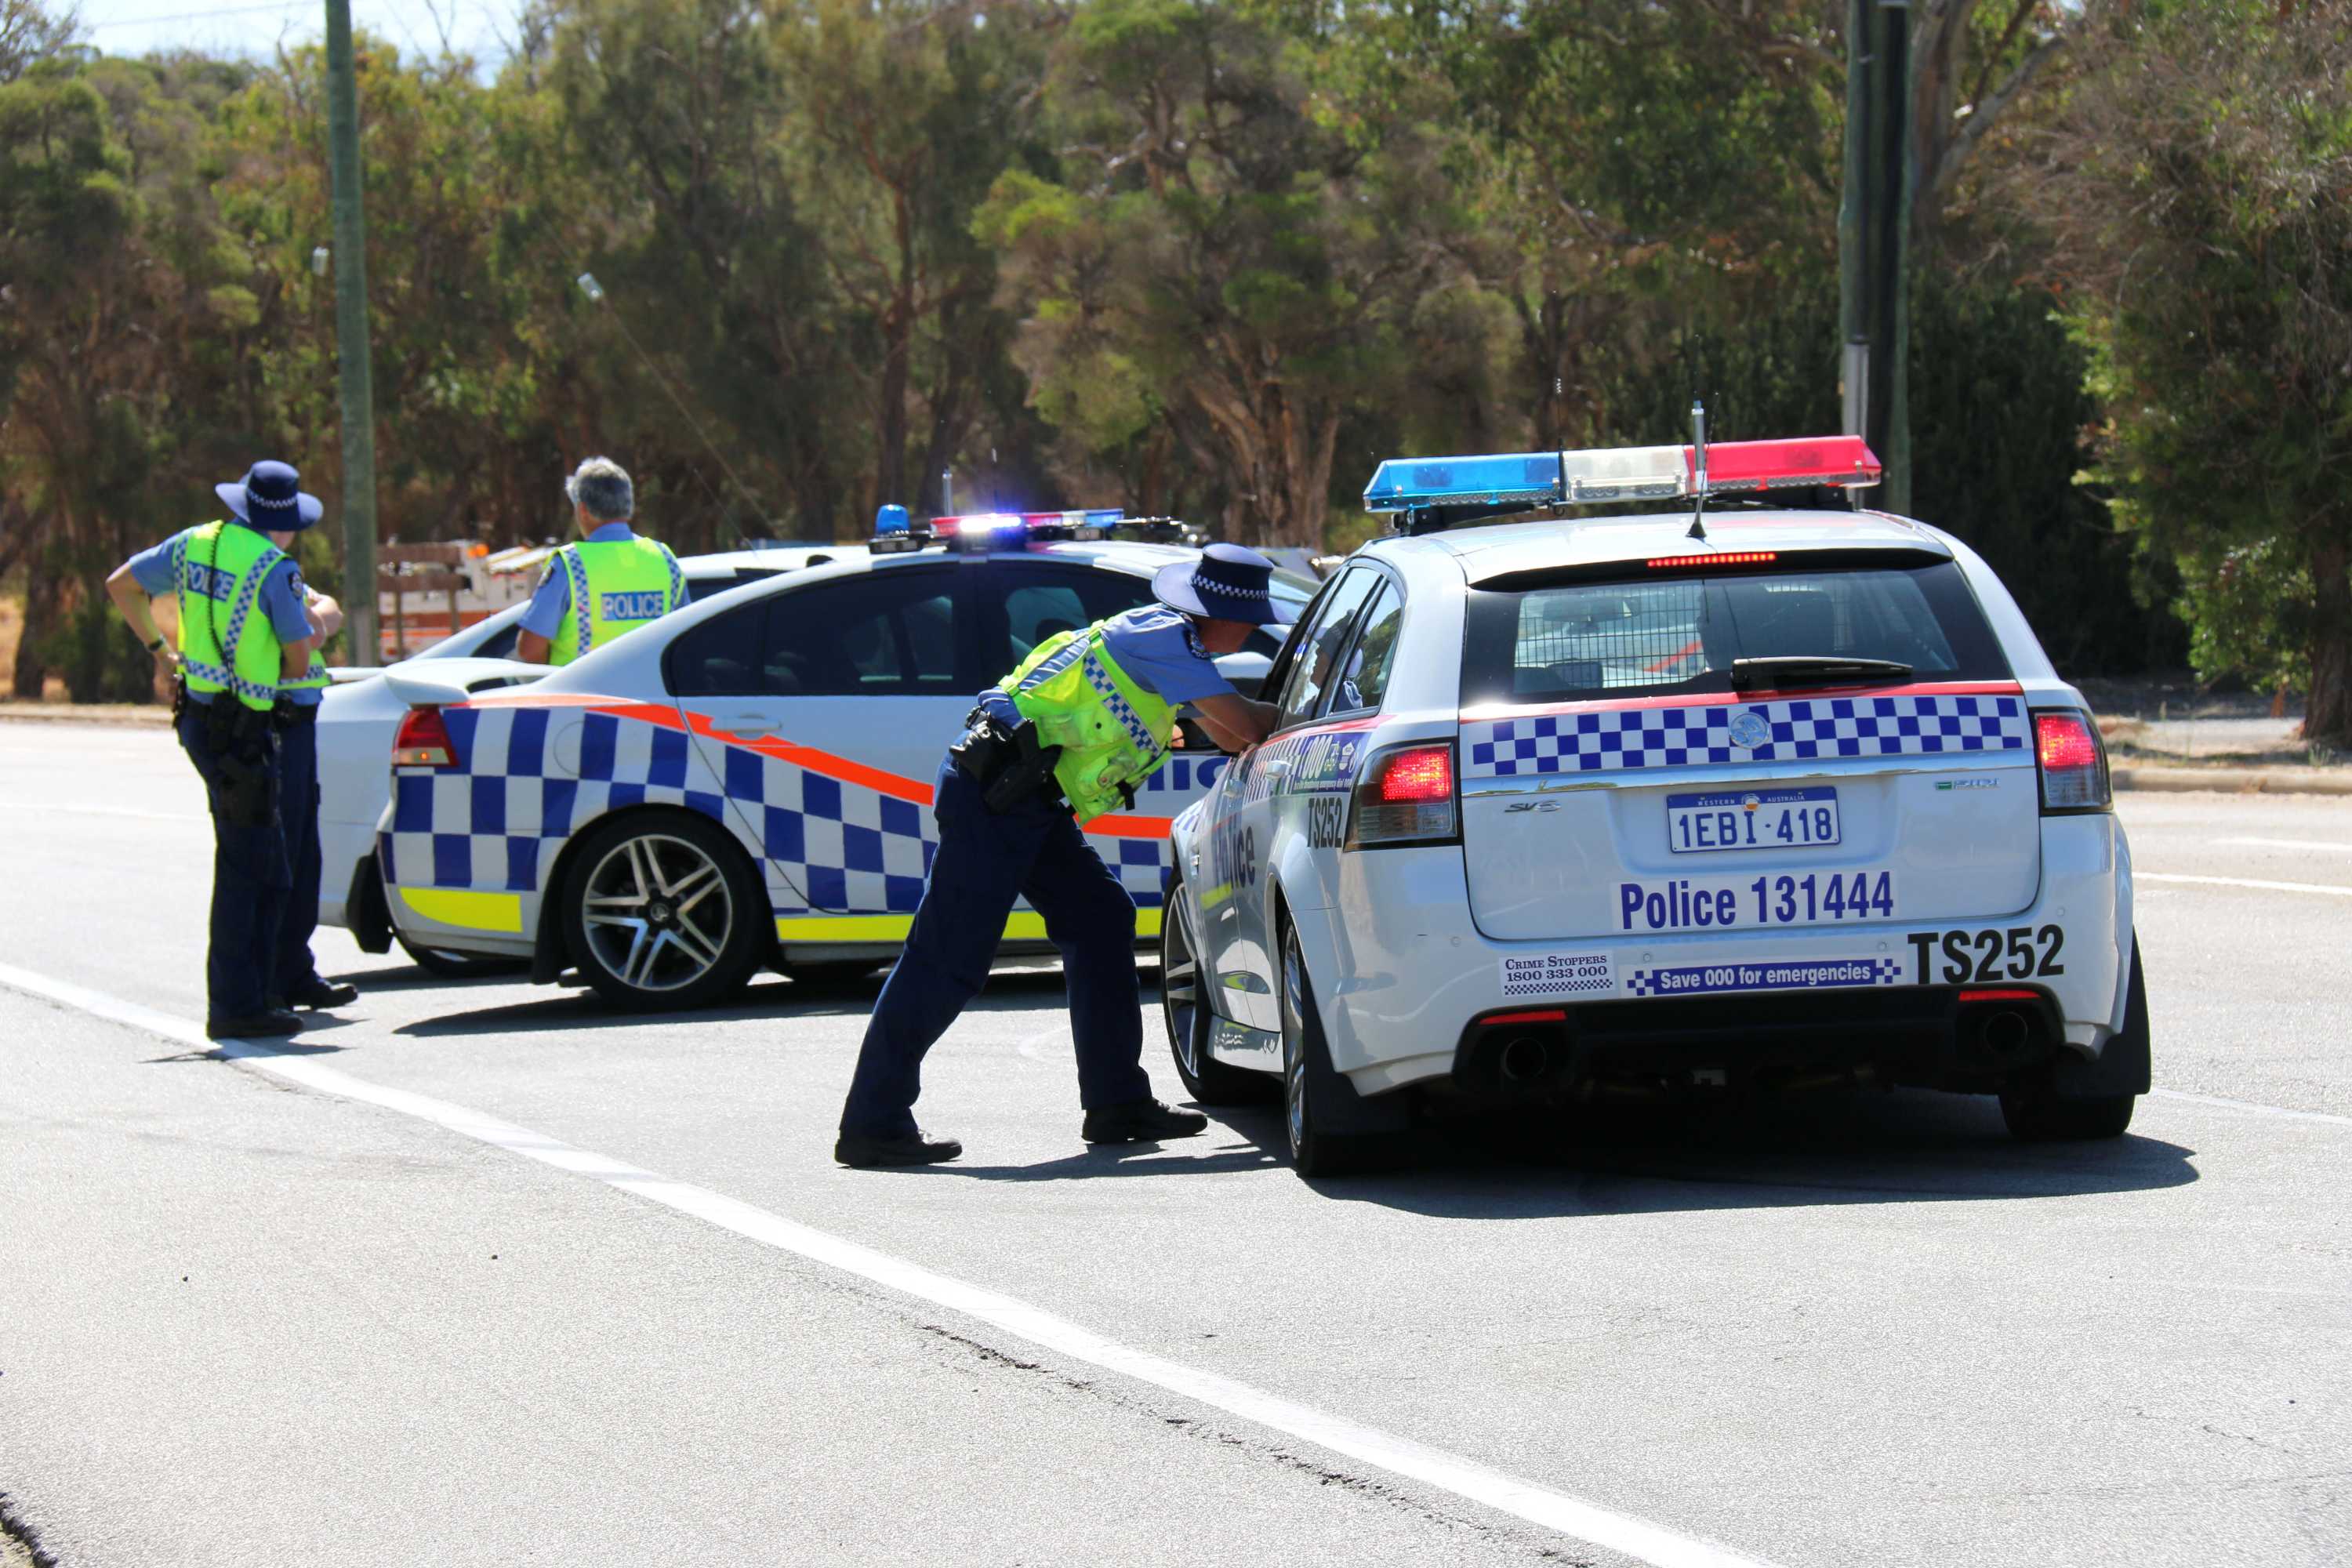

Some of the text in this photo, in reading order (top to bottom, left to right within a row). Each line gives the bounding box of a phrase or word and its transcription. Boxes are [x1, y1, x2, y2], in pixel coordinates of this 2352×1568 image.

[602, 593, 663, 618] POLICE
[1307, 797, 1343, 849] TS252
[1621, 871, 1894, 929] Police 131444
[1507, 965, 1608, 982] 1800 333 000
[1907, 924, 2064, 985] TS252
[1660, 962, 1871, 989] Save 000 for emergencies
